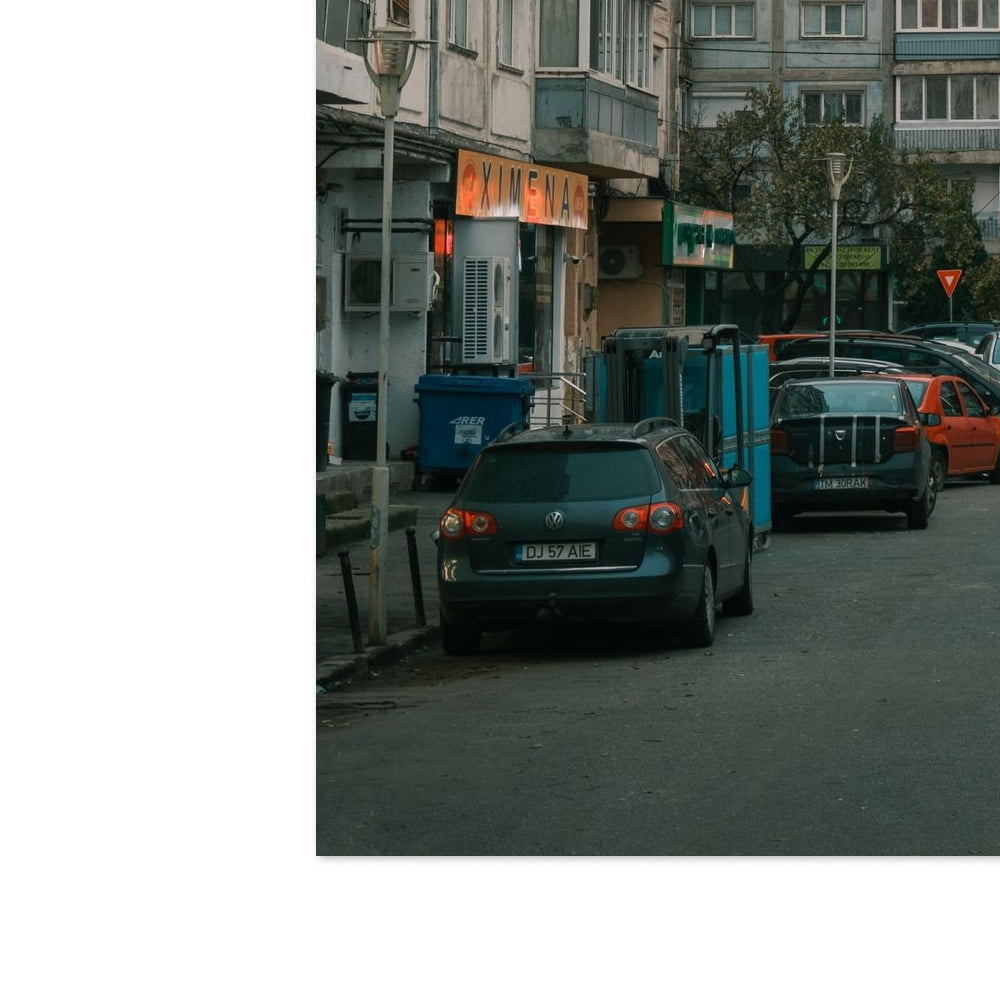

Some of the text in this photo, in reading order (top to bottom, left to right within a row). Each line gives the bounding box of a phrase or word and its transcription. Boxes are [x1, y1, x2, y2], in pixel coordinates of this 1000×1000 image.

[480, 160, 571, 221] XIMENA
[526, 544, 592, 559] DJ 57 AIE
